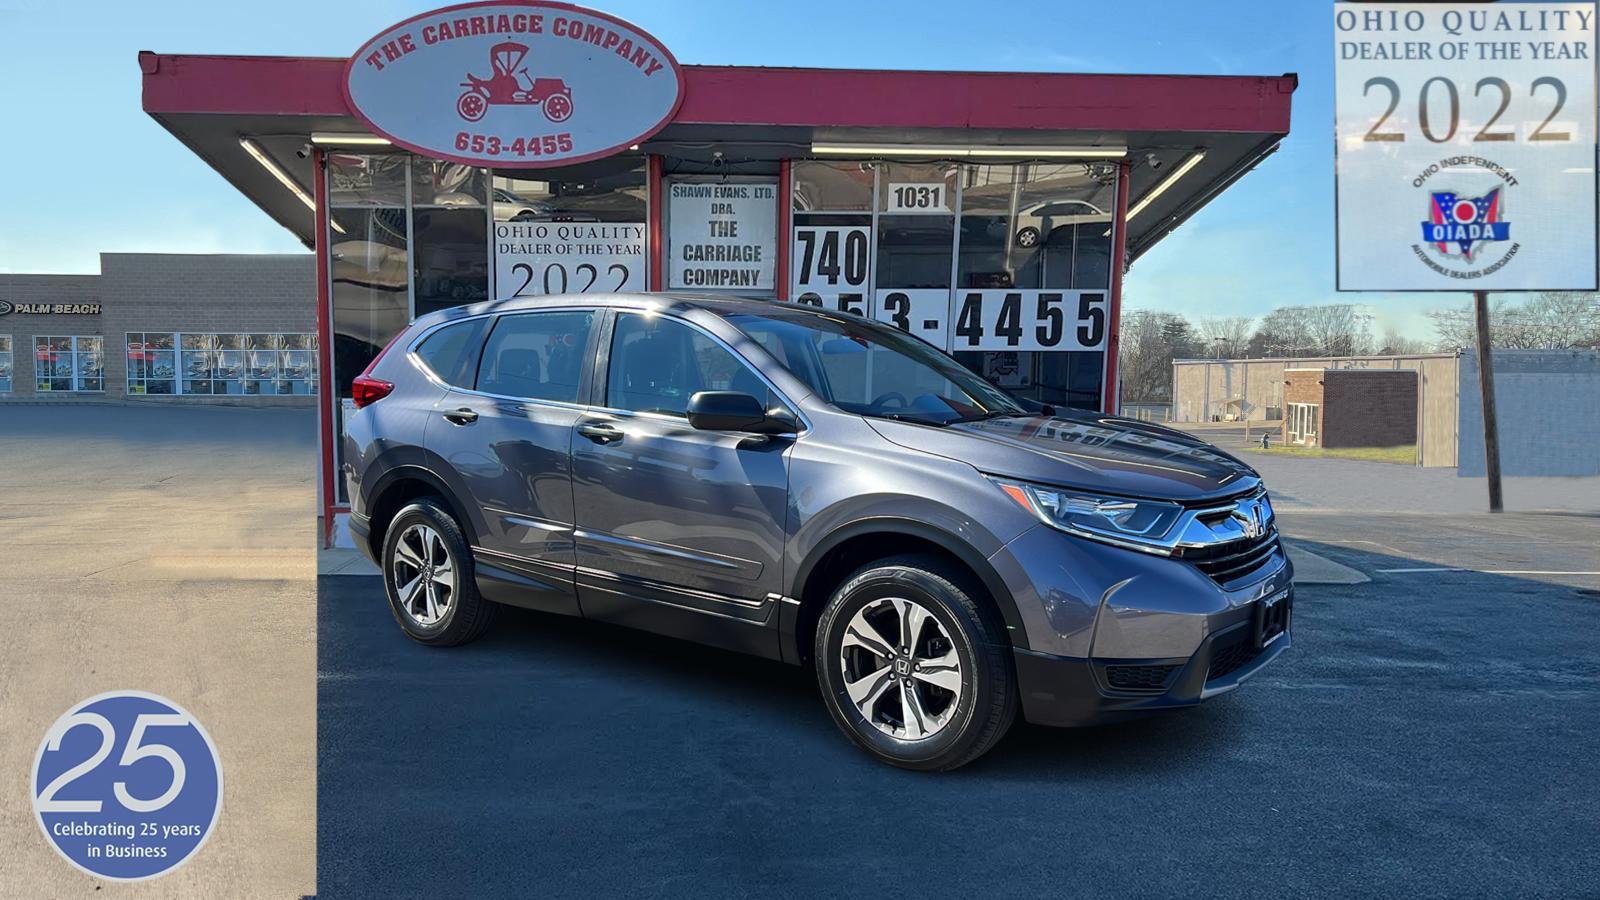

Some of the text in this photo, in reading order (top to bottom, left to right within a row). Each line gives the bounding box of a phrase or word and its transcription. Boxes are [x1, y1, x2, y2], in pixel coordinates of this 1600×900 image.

[1336, 10, 1593, 36] OHIO QUALITY
[365, 14, 664, 77] THE CARRIAGE COMPANY
[1340, 42, 1589, 60] DEALER OF THE YEAR
[1363, 76, 1571, 143] 2022
[455, 131, 573, 156] 653-4455
[1412, 155, 1519, 188] OHIO INDEPENDENT
[672, 185, 712, 198] SHAWN
[754, 187, 775, 200] LTD.
[894, 186, 940, 208] 1031
[711, 203, 736, 215] DBA.
[497, 225, 644, 241] OHIO QUALITY
[708, 220, 738, 238] THE
[1432, 224, 1495, 240] OIADA
[499, 243, 642, 255] DEALER OF THE YEAR
[682, 244, 762, 262] CARRIAGE
[797, 229, 868, 286] 740
[511, 262, 630, 298] 2022
[682, 268, 761, 287] COMPANY
[14, 303, 100, 314] PALM BEACH
